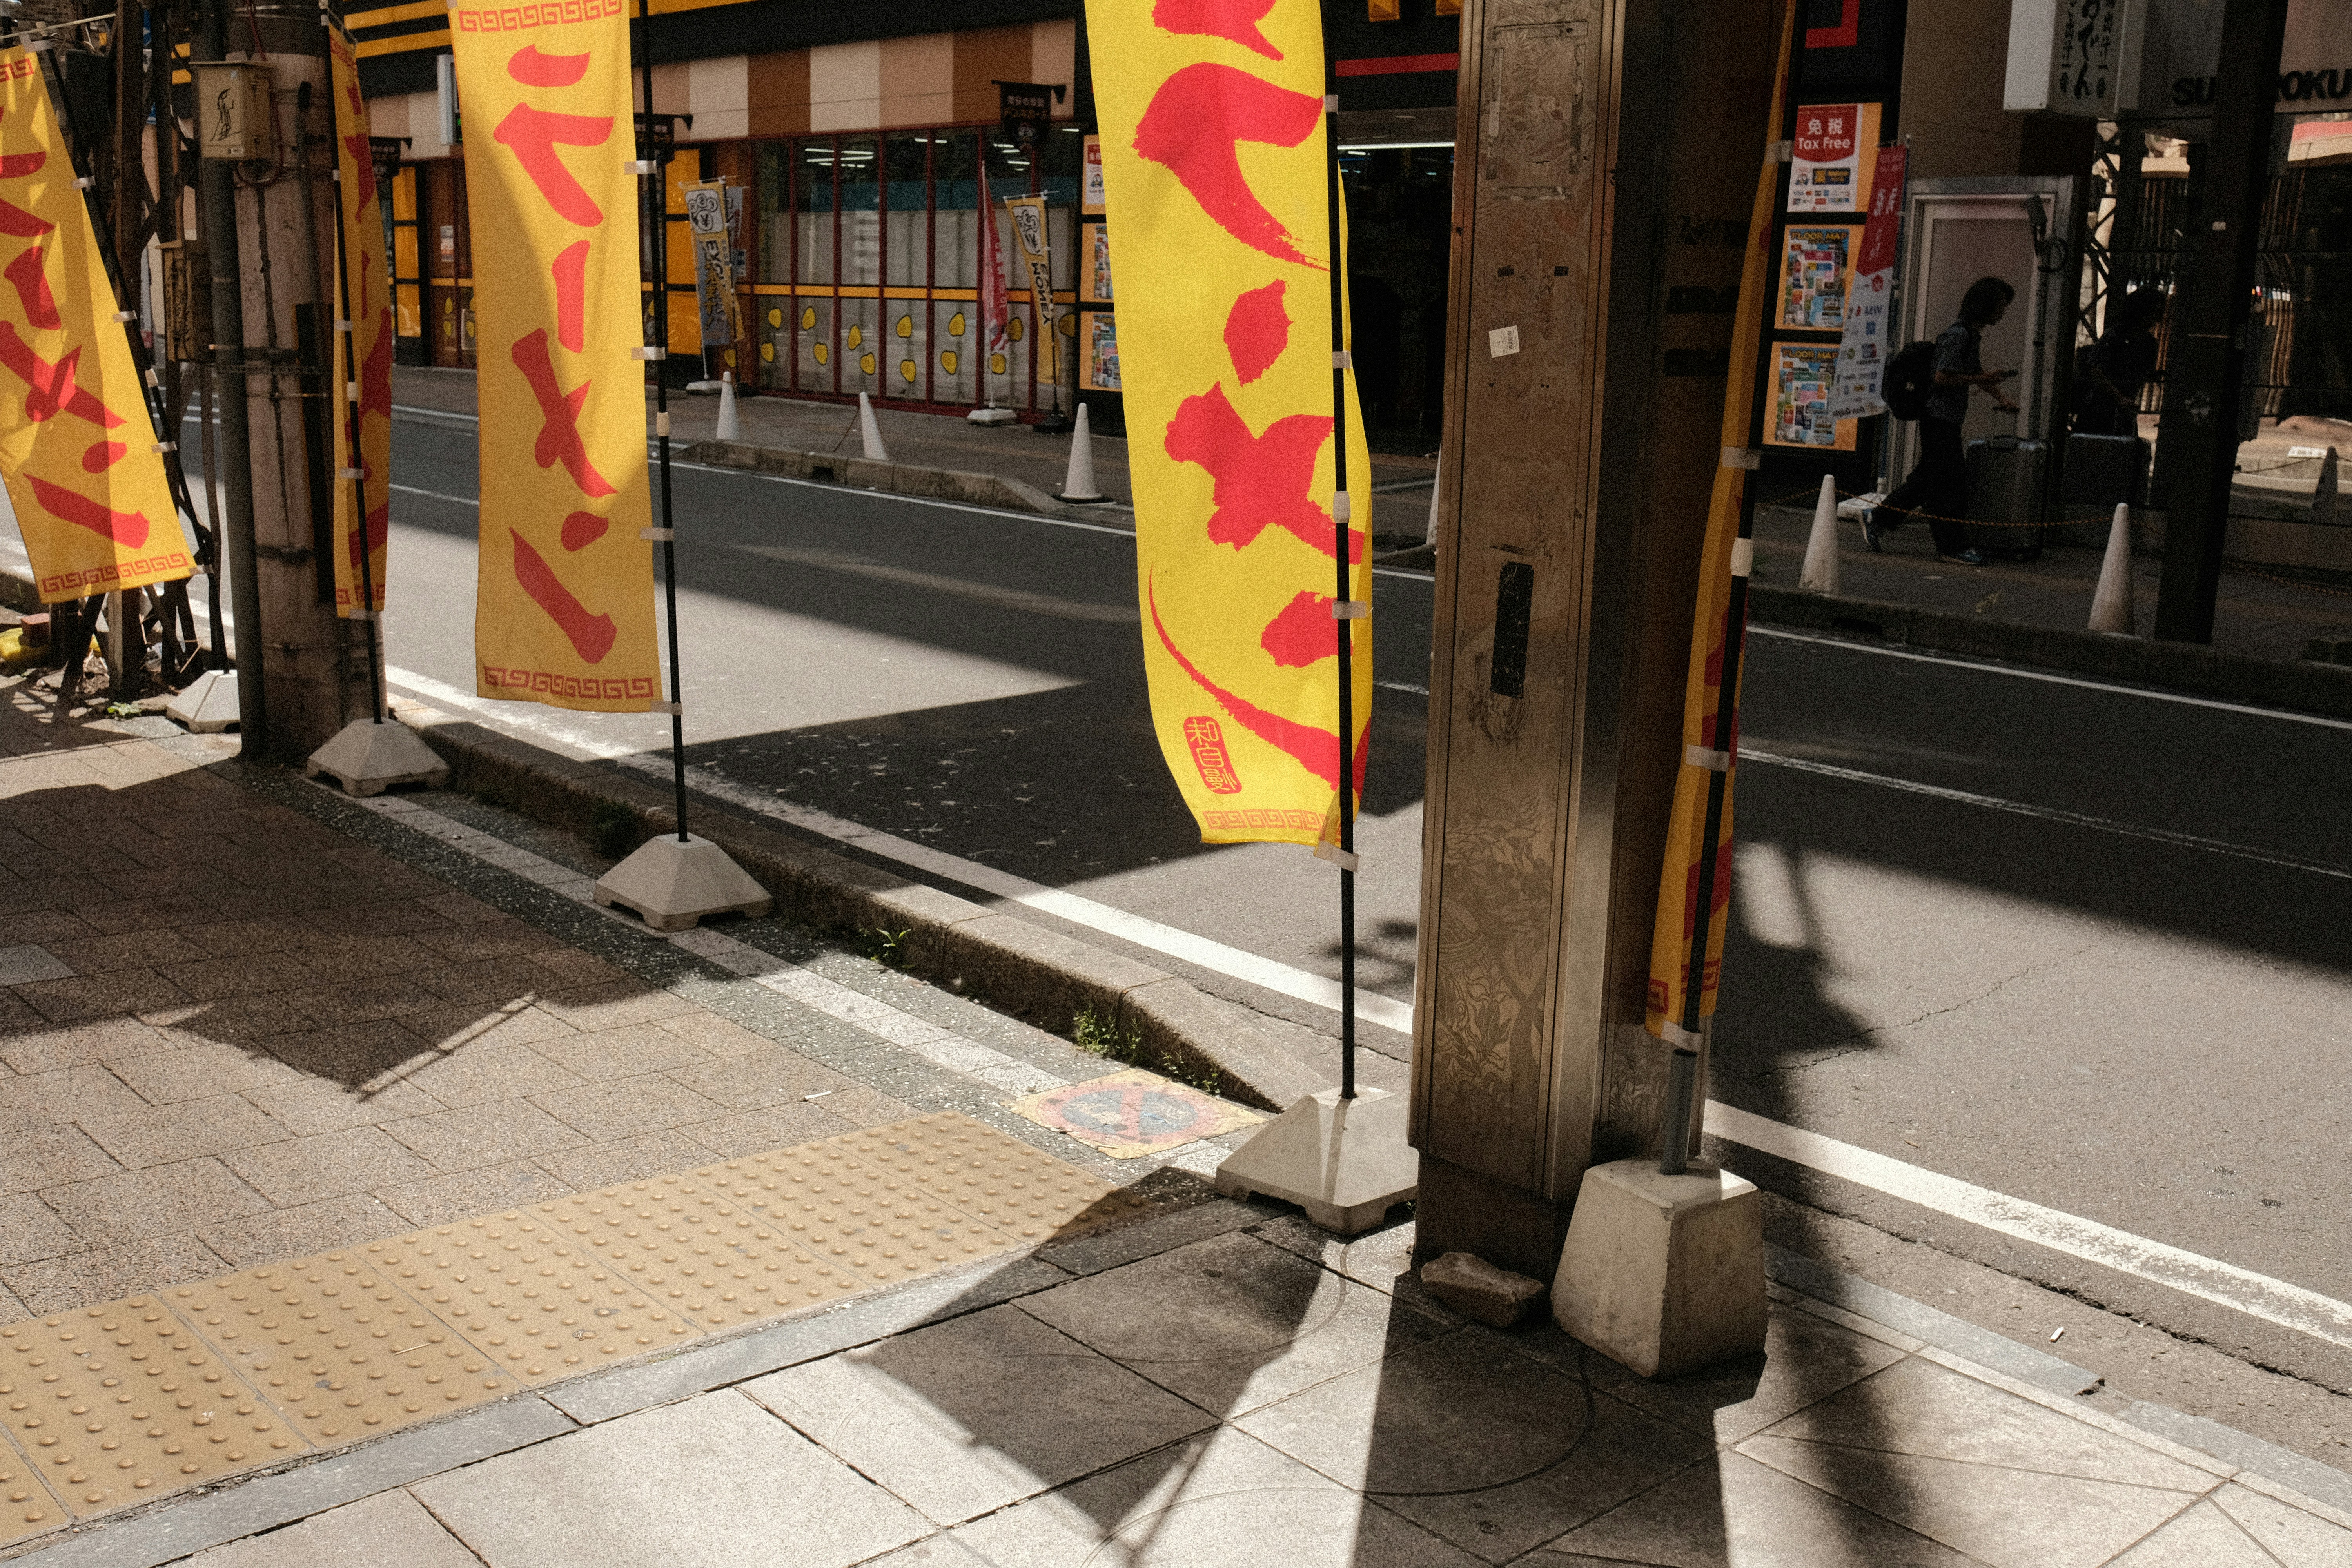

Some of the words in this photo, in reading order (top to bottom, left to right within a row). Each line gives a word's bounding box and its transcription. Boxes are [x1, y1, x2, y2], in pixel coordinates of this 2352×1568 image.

[1808, 117, 1843, 135] 免税
[1798, 137, 1820, 149] Tax
[1823, 137, 1851, 149] Free
[1791, 231, 1823, 240] FLOOR
[1826, 232, 1848, 240] MAP
[1782, 349, 1815, 358] FLOOR
